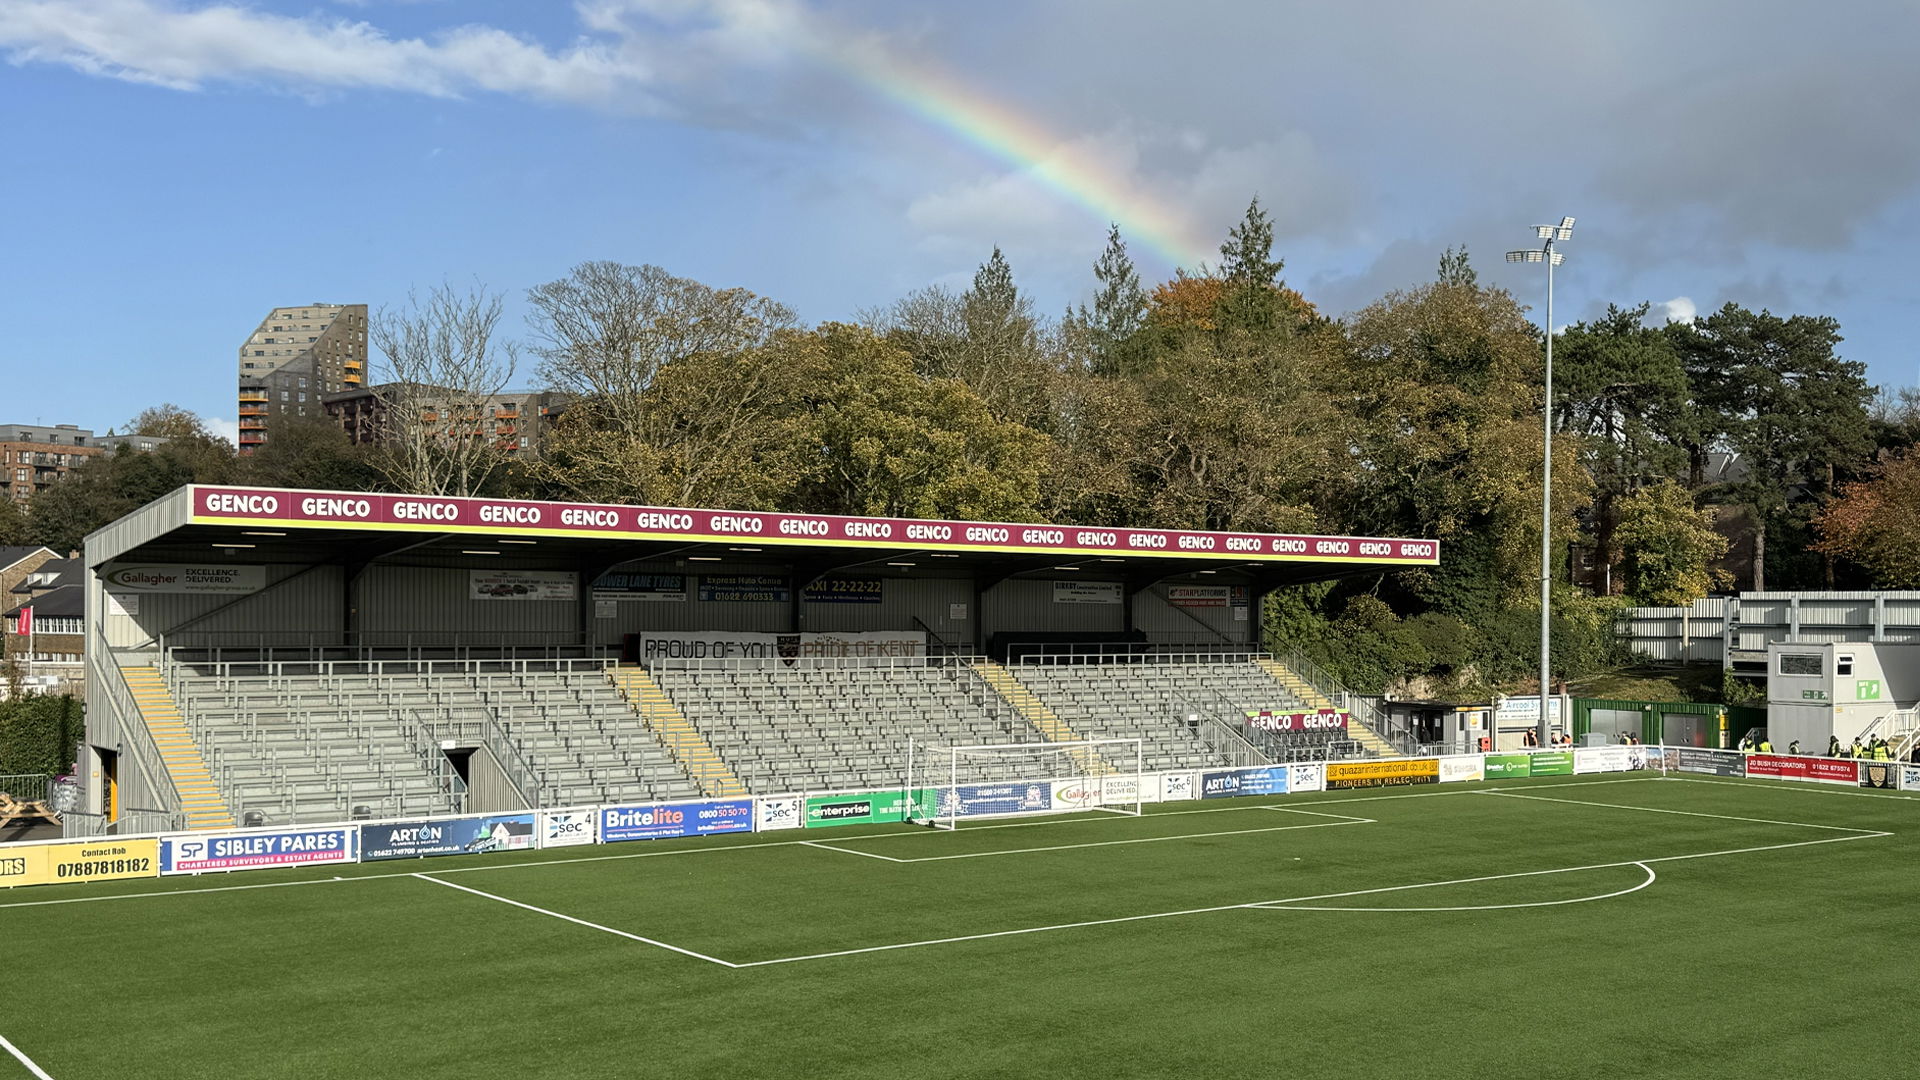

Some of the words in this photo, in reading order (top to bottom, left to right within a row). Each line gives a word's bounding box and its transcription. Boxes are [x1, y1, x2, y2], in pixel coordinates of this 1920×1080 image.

[206, 494, 277, 514] GENCO
[302, 498, 370, 517] GENCO
[394, 502, 458, 521] GENCO
[480, 506, 540, 524] GENCO
[561, 509, 618, 527] GENCO
[638, 513, 692, 530] GENCO
[711, 516, 762, 533] GENCO
[779, 519, 828, 536] GENCO
[845, 522, 891, 538] GENCO
[906, 525, 951, 540] GENCO
[966, 527, 1008, 542] GENCO
[1023, 530, 1064, 545] GENCO
[1077, 532, 1116, 546] GENCO
[1129, 534, 1166, 548] GENCO
[1179, 536, 1214, 550] GENCO
[1226, 538, 1261, 552] GENCO
[1272, 540, 1306, 553] GENCO
[1316, 541, 1349, 554] GENCO
[1359, 543, 1391, 556] GENCO
[1400, 544, 1431, 557] GENCO
[121, 573, 177, 585] Gallagher
[186, 568, 240, 576] EXCELLENCE.
[593, 575, 628, 587] OWER
[629, 575, 655, 588] LANE
[654, 575, 681, 588] TYRES
[805, 580, 827, 592] AXI
[715, 592, 740, 600] 01622
[742, 592, 774, 600] 690333
[645, 639, 707, 659] PROUD
[713, 641, 735, 659] OF
[855, 641, 875, 657] OF
[878, 640, 919, 657] KENT
[1505, 701, 1530, 709] Aircool
[1251, 714, 1292, 730] GENCO
[1303, 713, 1342, 729] GENCO
[1339, 763, 1428, 775] quazarinternational.co.uk
[1771, 761, 1806, 769] DECORATORS
[1172, 783, 1186, 791] sec
[1186, 776, 1191, 785] 6
[1206, 775, 1239, 791] ARTON
[1335, 780, 1371, 788] PIONEERS
[699, 810, 718, 818] 0800
[718, 809, 728, 817] 50
[772, 808, 791, 818] sec
[791, 800, 798, 811] 5
[810, 806, 869, 817] enterprise
[559, 823, 582, 833] sec
[585, 814, 591, 824] 4
[607, 809, 684, 827] Britelite
[390, 825, 442, 842] ARTON
[82, 849, 111, 857] Contact
[112, 847, 126, 855] Rob
[215, 838, 278, 856] SIBLEY
[281, 833, 338, 851] PARES
[58, 858, 149, 877] 07887818182
[179, 861, 227, 869] CHARTERED
[229, 858, 279, 866] SURVEYORS
[285, 855, 312, 863] ESTATE
[313, 852, 343, 860] AGENTS
